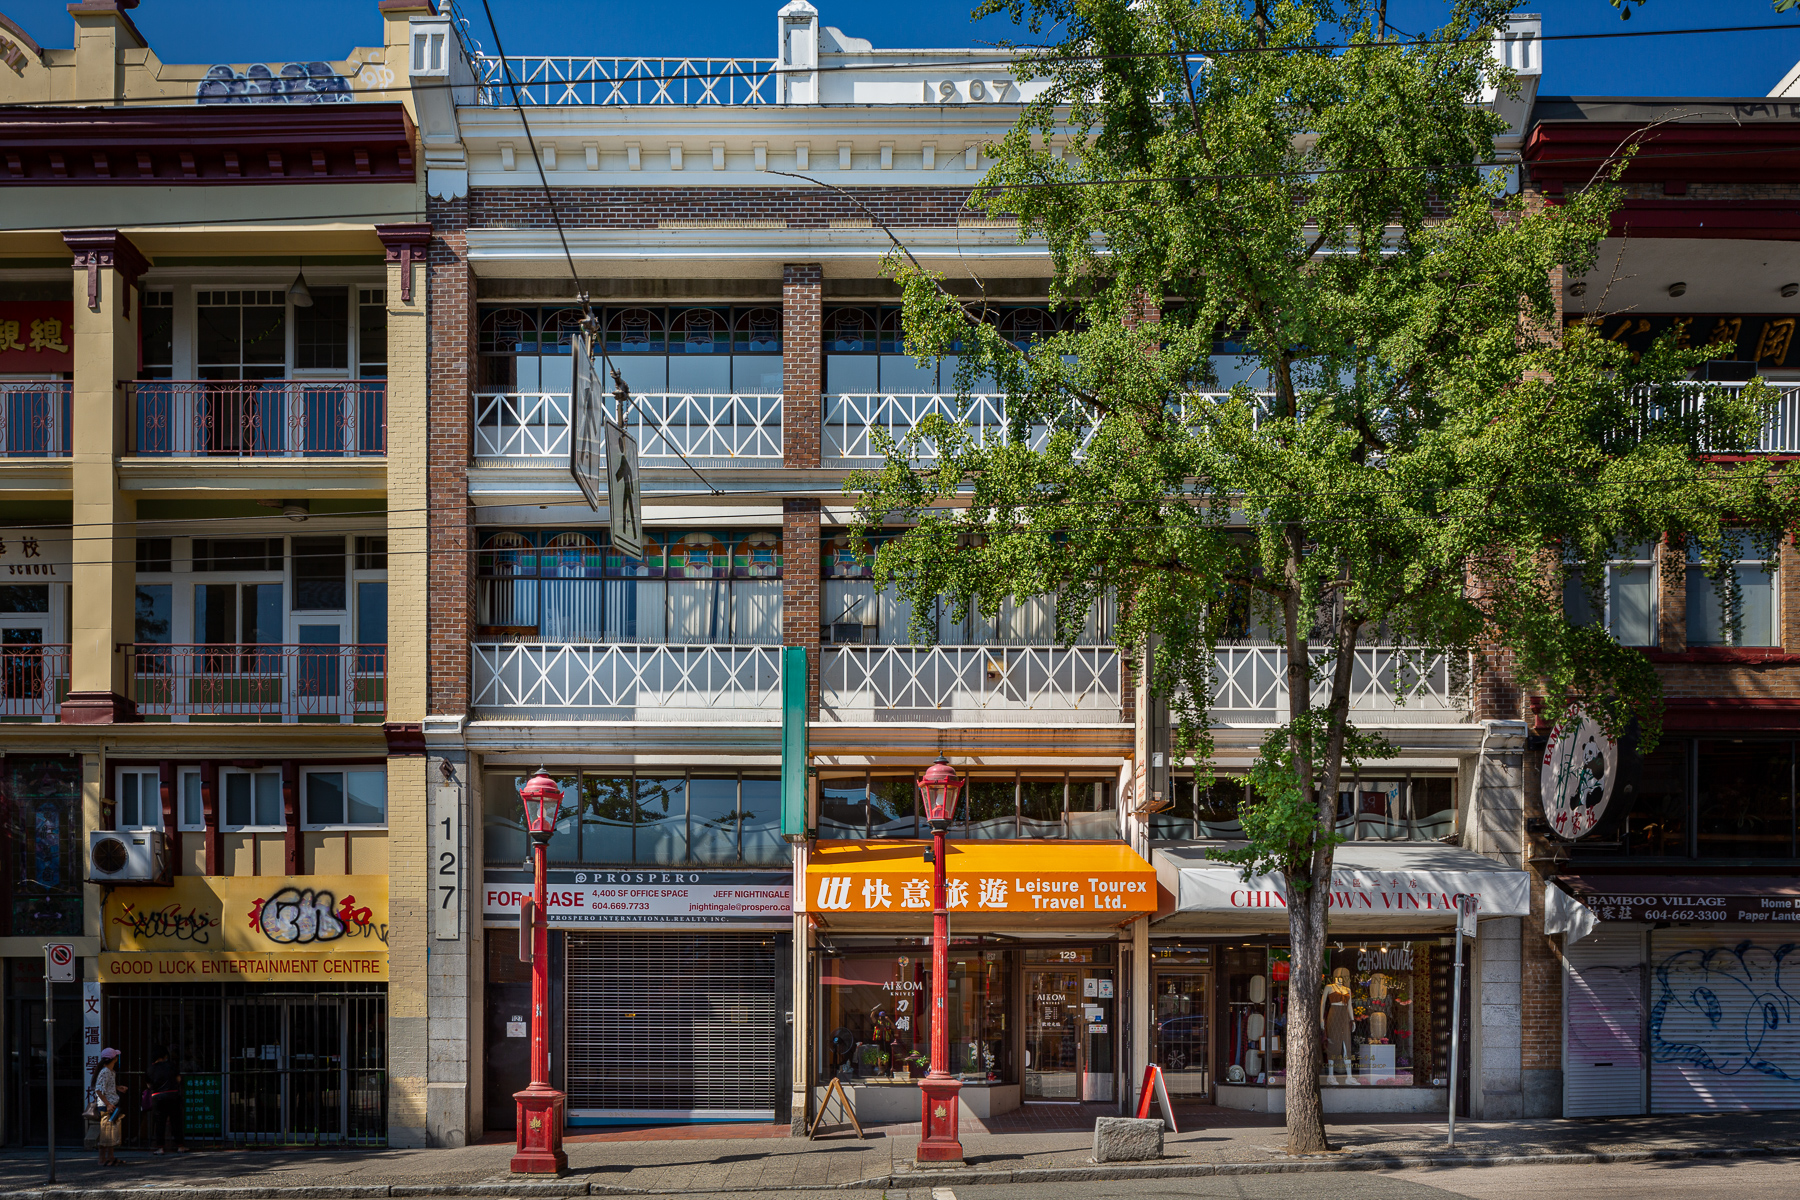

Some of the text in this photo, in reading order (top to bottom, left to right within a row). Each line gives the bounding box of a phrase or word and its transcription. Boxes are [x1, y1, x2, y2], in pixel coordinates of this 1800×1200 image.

[923, 79, 1013, 103] 1907
[9, 564, 56, 575] SCHOOL
[439, 817, 456, 910] 127
[593, 873, 700, 883] PROSPERO
[1015, 877, 1147, 893] Leisure Tourex
[592, 889, 616, 899] 4,400
[630, 889, 659, 898] OFFICE
[660, 889, 689, 898] SPACE
[713, 890, 790, 899] JEFF NIGHTINGALE
[861, 877, 1008, 909] 快意旅遊
[592, 902, 650, 910] 604.669.7733
[1031, 894, 1127, 909] Travel Ltd.
[1587, 896, 1727, 906] BAMBOO VILLAGE
[1760, 898, 1792, 908] Home
[689, 902, 791, 912] jnightingale@prospero.ca
[1644, 909, 1727, 921] 604-662-3300
[1737, 910, 1769, 922] Paper
[1059, 951, 1077, 959] 129
[110, 959, 380, 975] GOOD LUCK ENTERTAINMENT CENTRE
